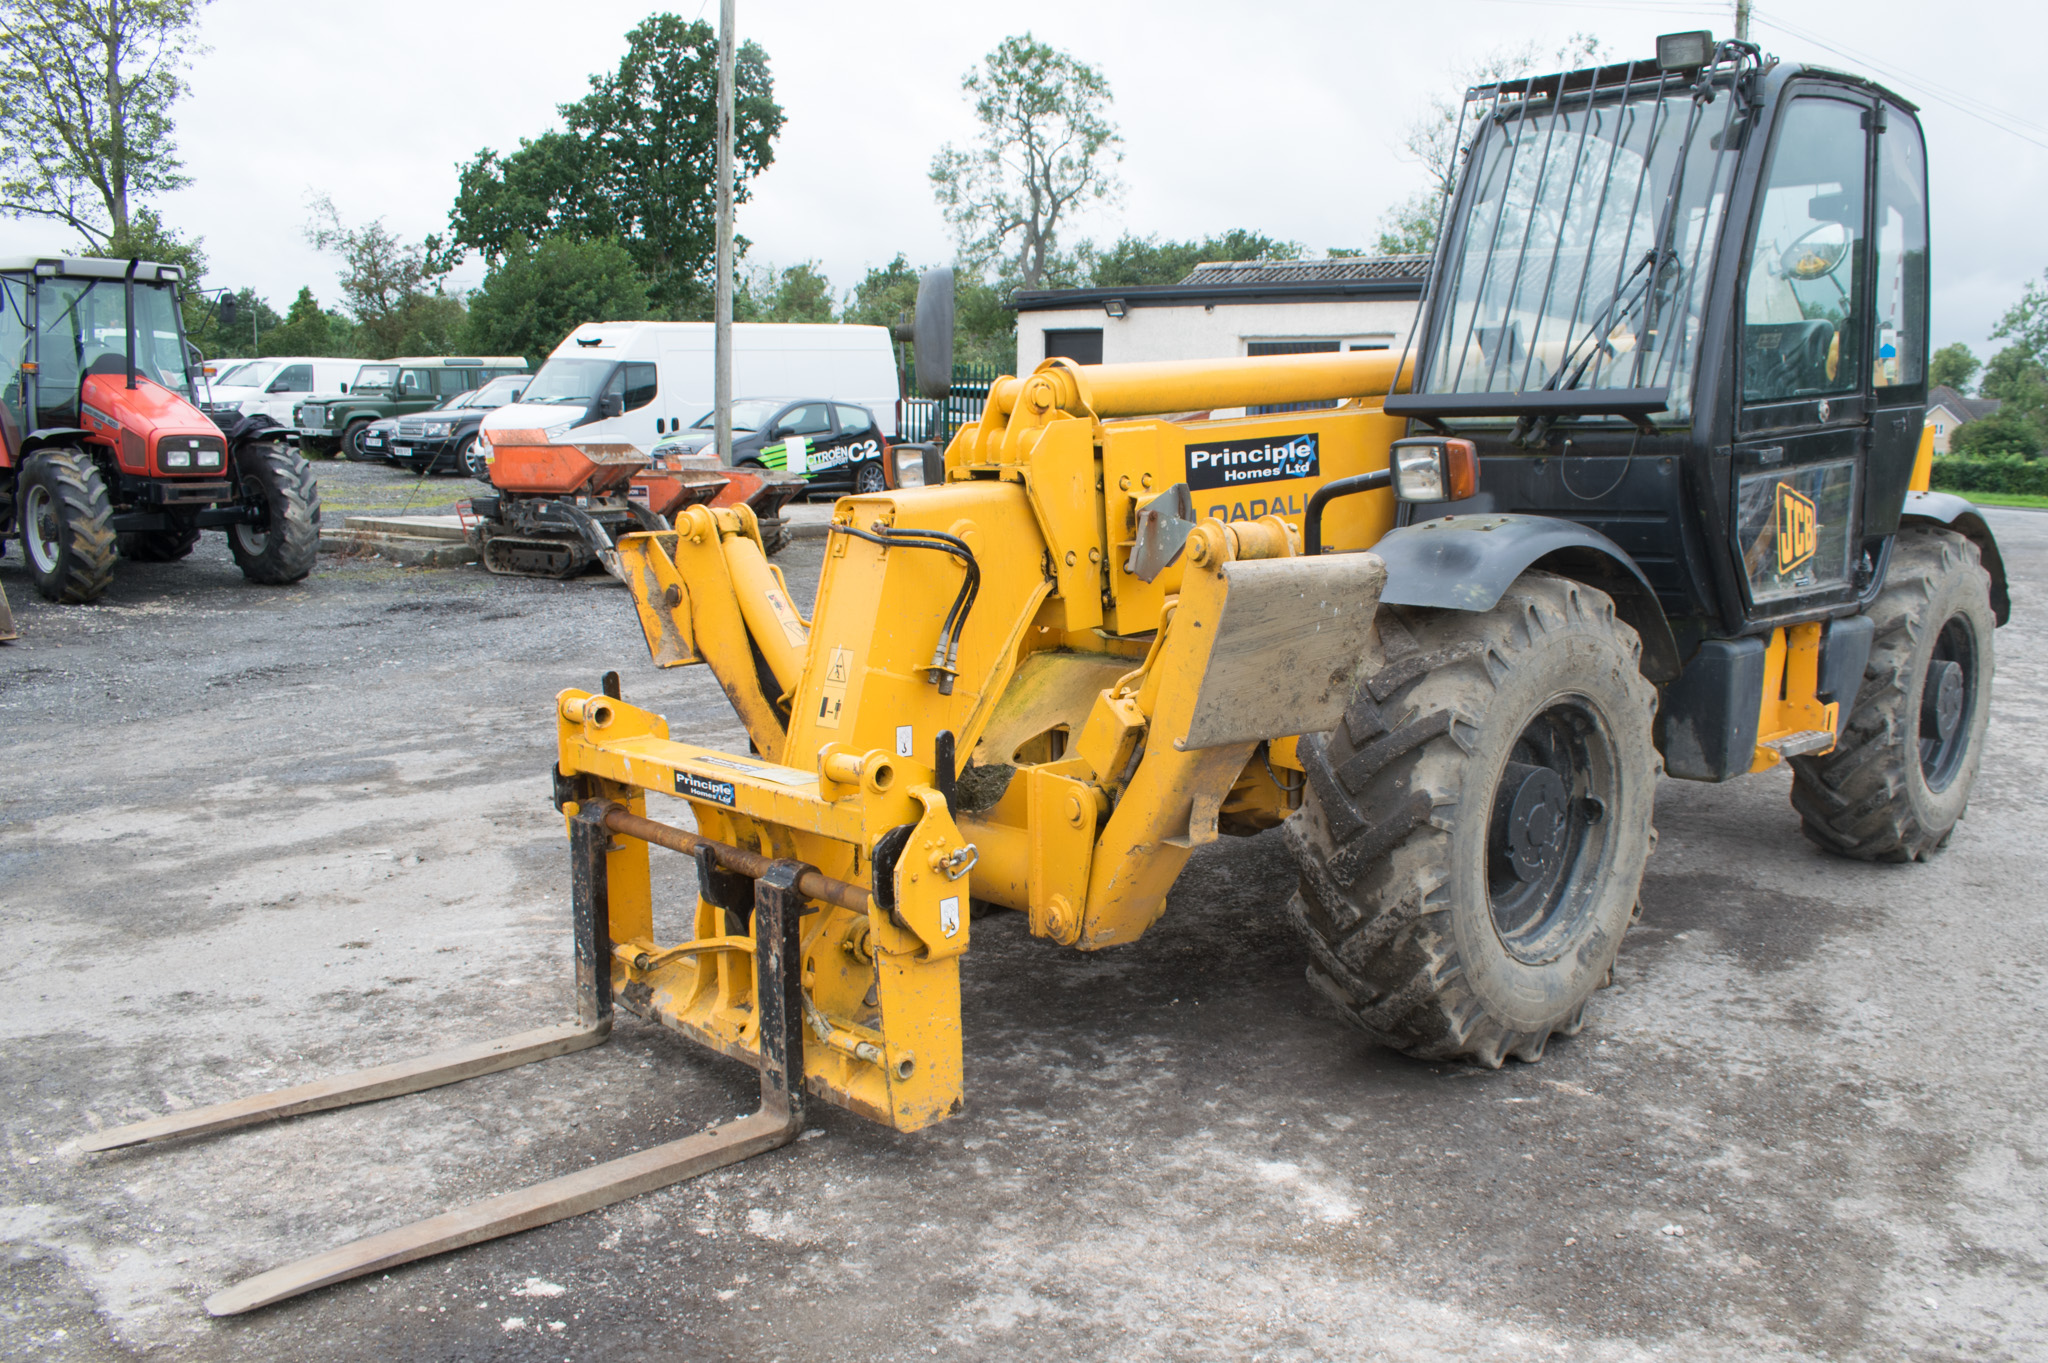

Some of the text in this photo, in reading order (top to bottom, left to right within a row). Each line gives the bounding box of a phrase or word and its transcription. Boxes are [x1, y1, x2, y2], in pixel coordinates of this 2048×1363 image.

[848, 439, 881, 463] C2
[1190, 441, 1311, 469] Principle
[1224, 461, 1310, 482] Homes Ltd
[1781, 493, 1814, 565] JCB
[675, 773, 732, 796] Principle
[690, 787, 732, 804] Homes Ltd
